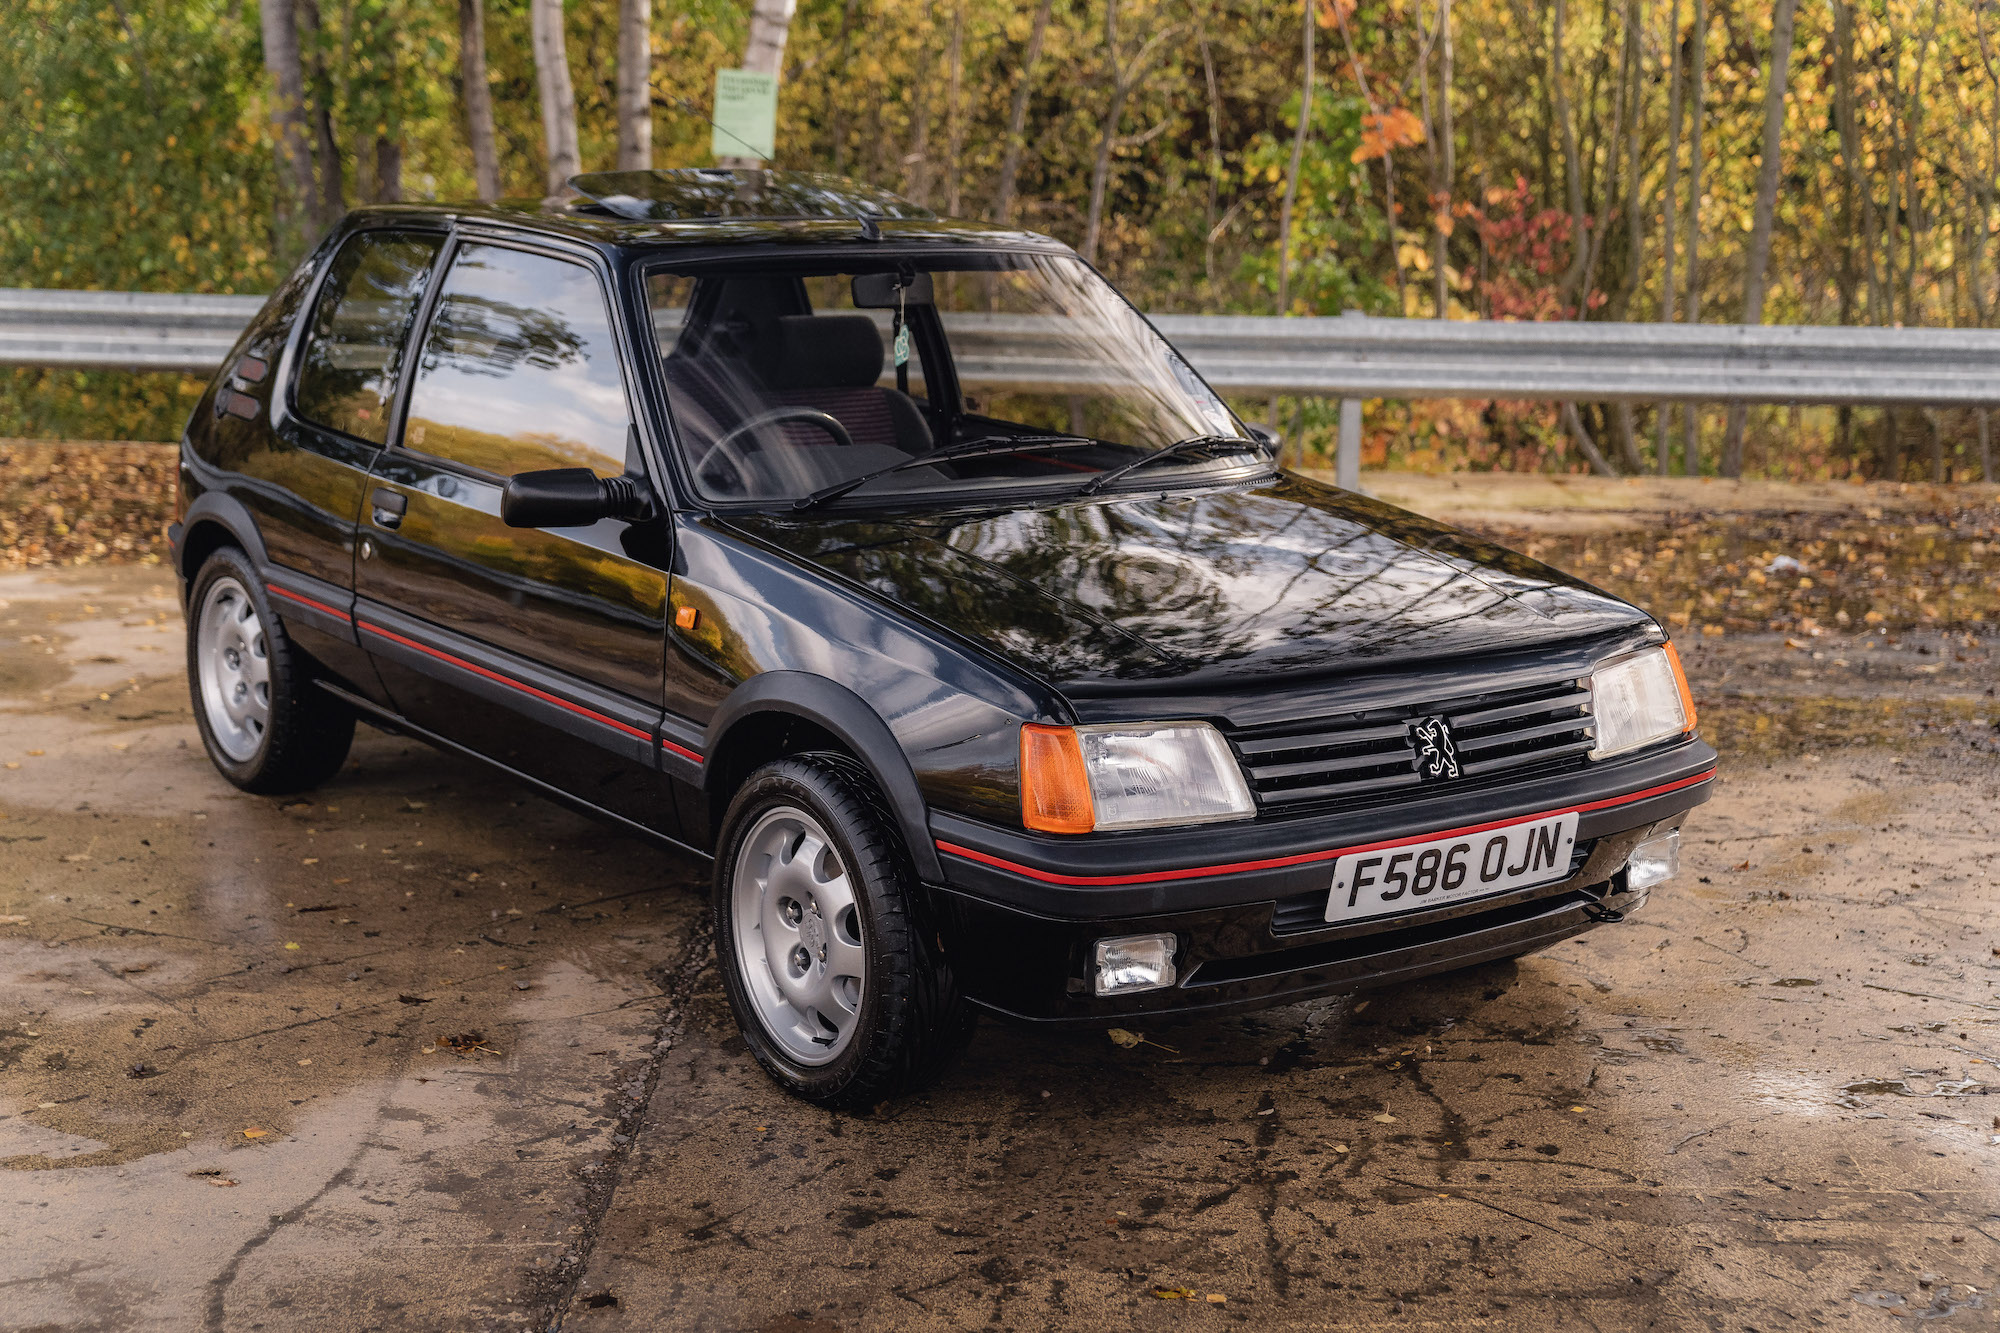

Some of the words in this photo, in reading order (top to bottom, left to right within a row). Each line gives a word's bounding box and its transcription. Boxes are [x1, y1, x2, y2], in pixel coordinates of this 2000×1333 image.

[1347, 843, 1470, 907] F586
[1480, 822, 1562, 883] OJN
[1446, 892, 1461, 900] MOTOR
[1462, 888, 1479, 896] FACTOR
